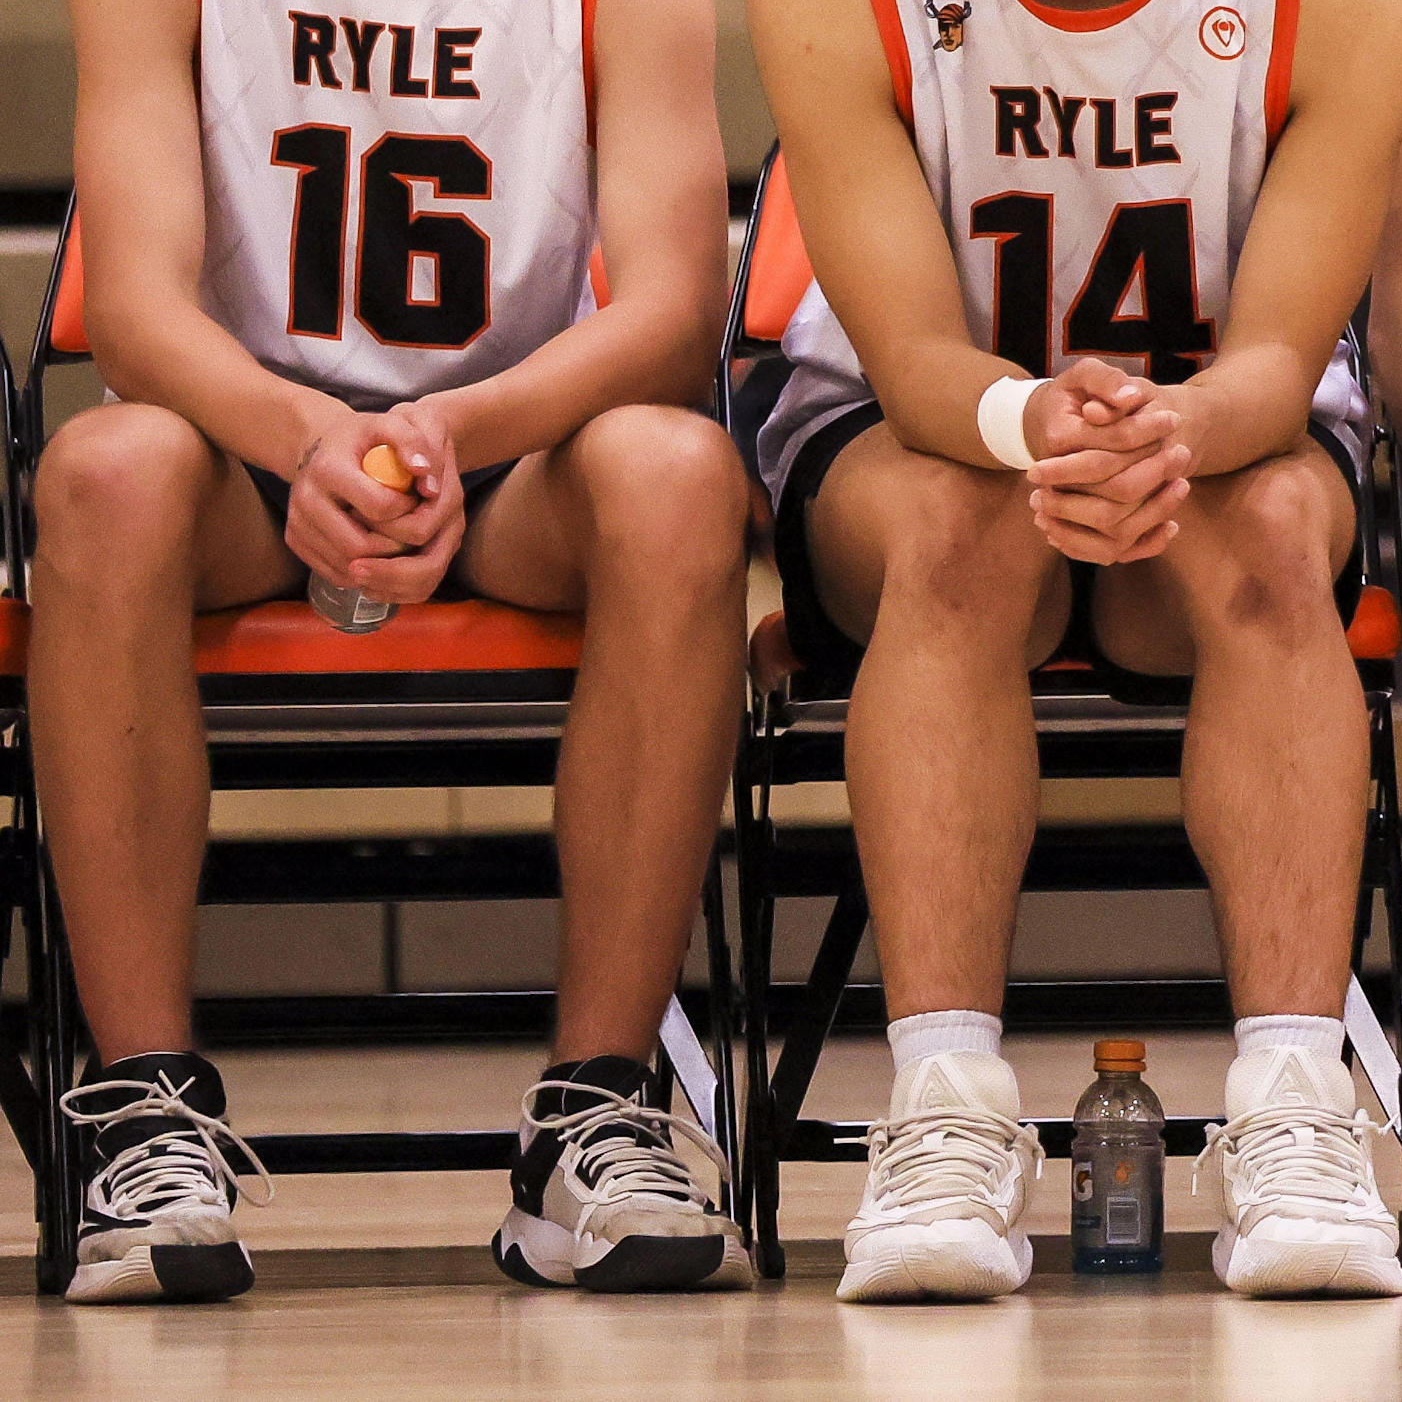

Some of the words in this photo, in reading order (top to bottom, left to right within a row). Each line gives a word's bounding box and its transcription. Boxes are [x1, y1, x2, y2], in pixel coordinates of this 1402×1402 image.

[288, 9, 482, 100] RYLE
[989, 84, 1181, 169] RYLE
[270, 121, 492, 350] 16
[970, 190, 1217, 385] 14
